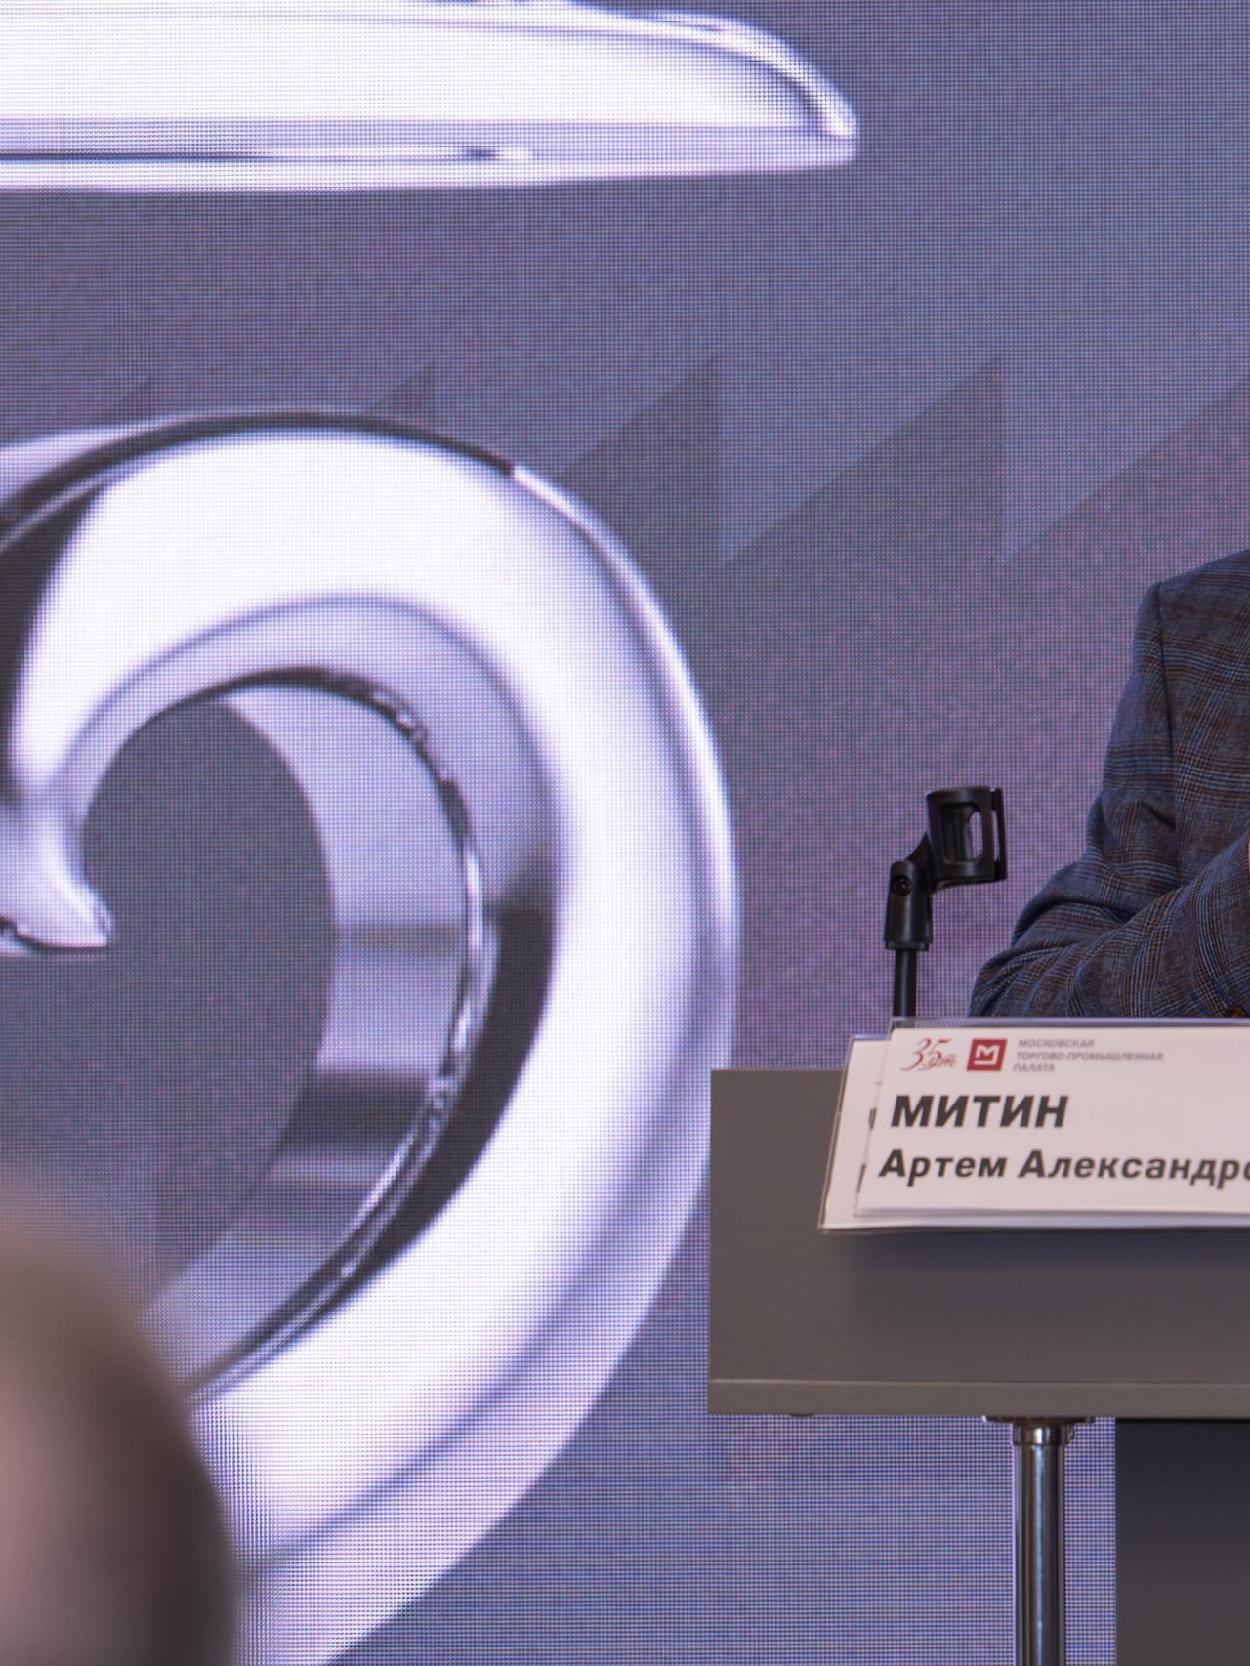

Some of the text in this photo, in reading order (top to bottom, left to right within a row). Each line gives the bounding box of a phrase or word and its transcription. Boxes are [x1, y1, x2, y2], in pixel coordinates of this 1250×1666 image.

[1018, 1038, 1095, 1048] МОСКОВСКАЯ
[1012, 1063, 1055, 1072] ПАЛАТА
[891, 1095, 1069, 1128] МИТИН
[878, 1149, 1008, 1187] Артем
